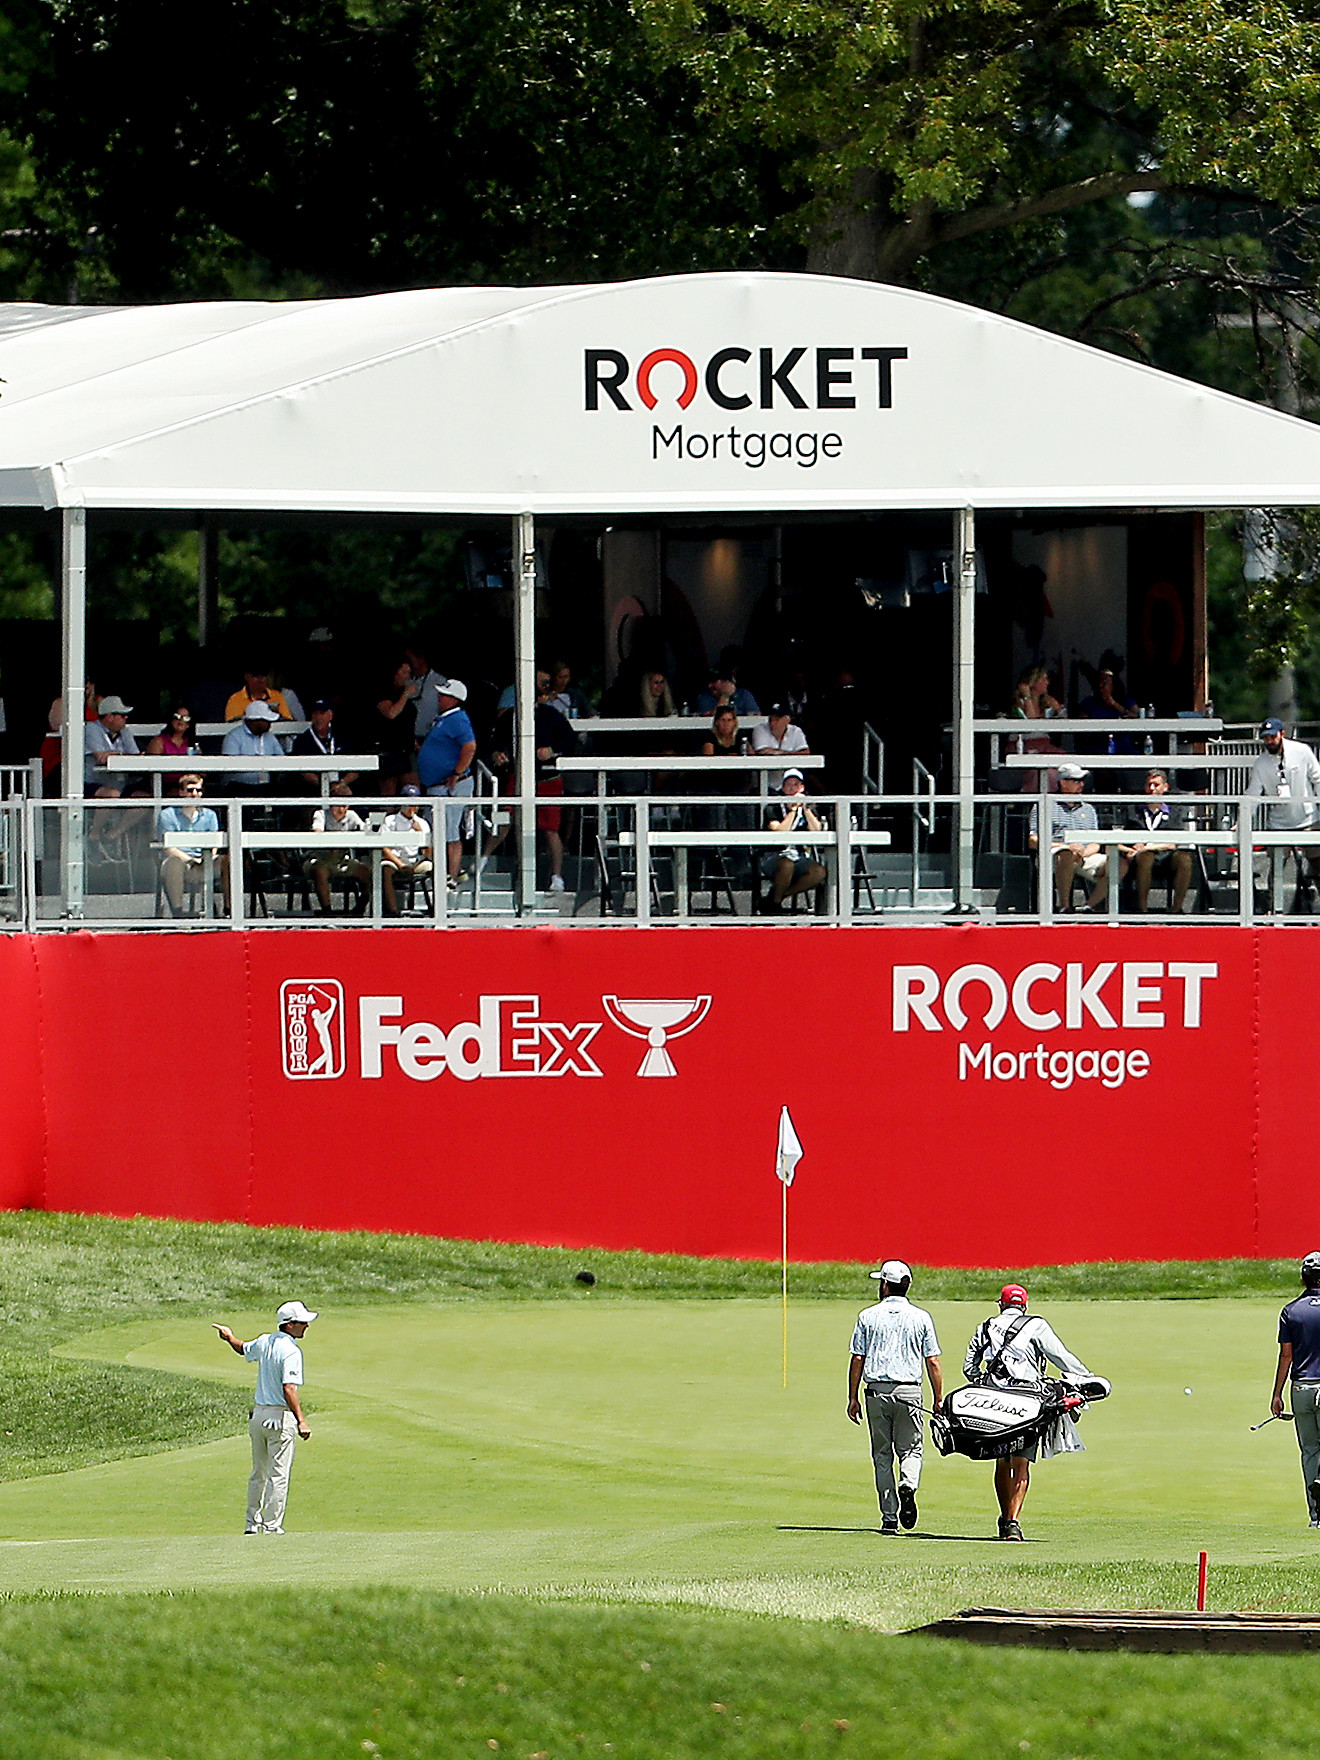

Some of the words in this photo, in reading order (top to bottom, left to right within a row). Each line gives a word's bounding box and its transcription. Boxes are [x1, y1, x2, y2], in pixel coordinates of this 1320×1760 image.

[584, 347, 908, 411] ROCKET
[652, 424, 843, 468] Mortgage
[288, 993, 316, 1005] PGA
[892, 962, 1218, 1031] ROCKET
[288, 1004, 309, 1072] TOUR
[358, 995, 604, 1081] FedEx
[957, 1042, 1150, 1090] Mortgage
[957, 1391, 1028, 1418] Titleist
